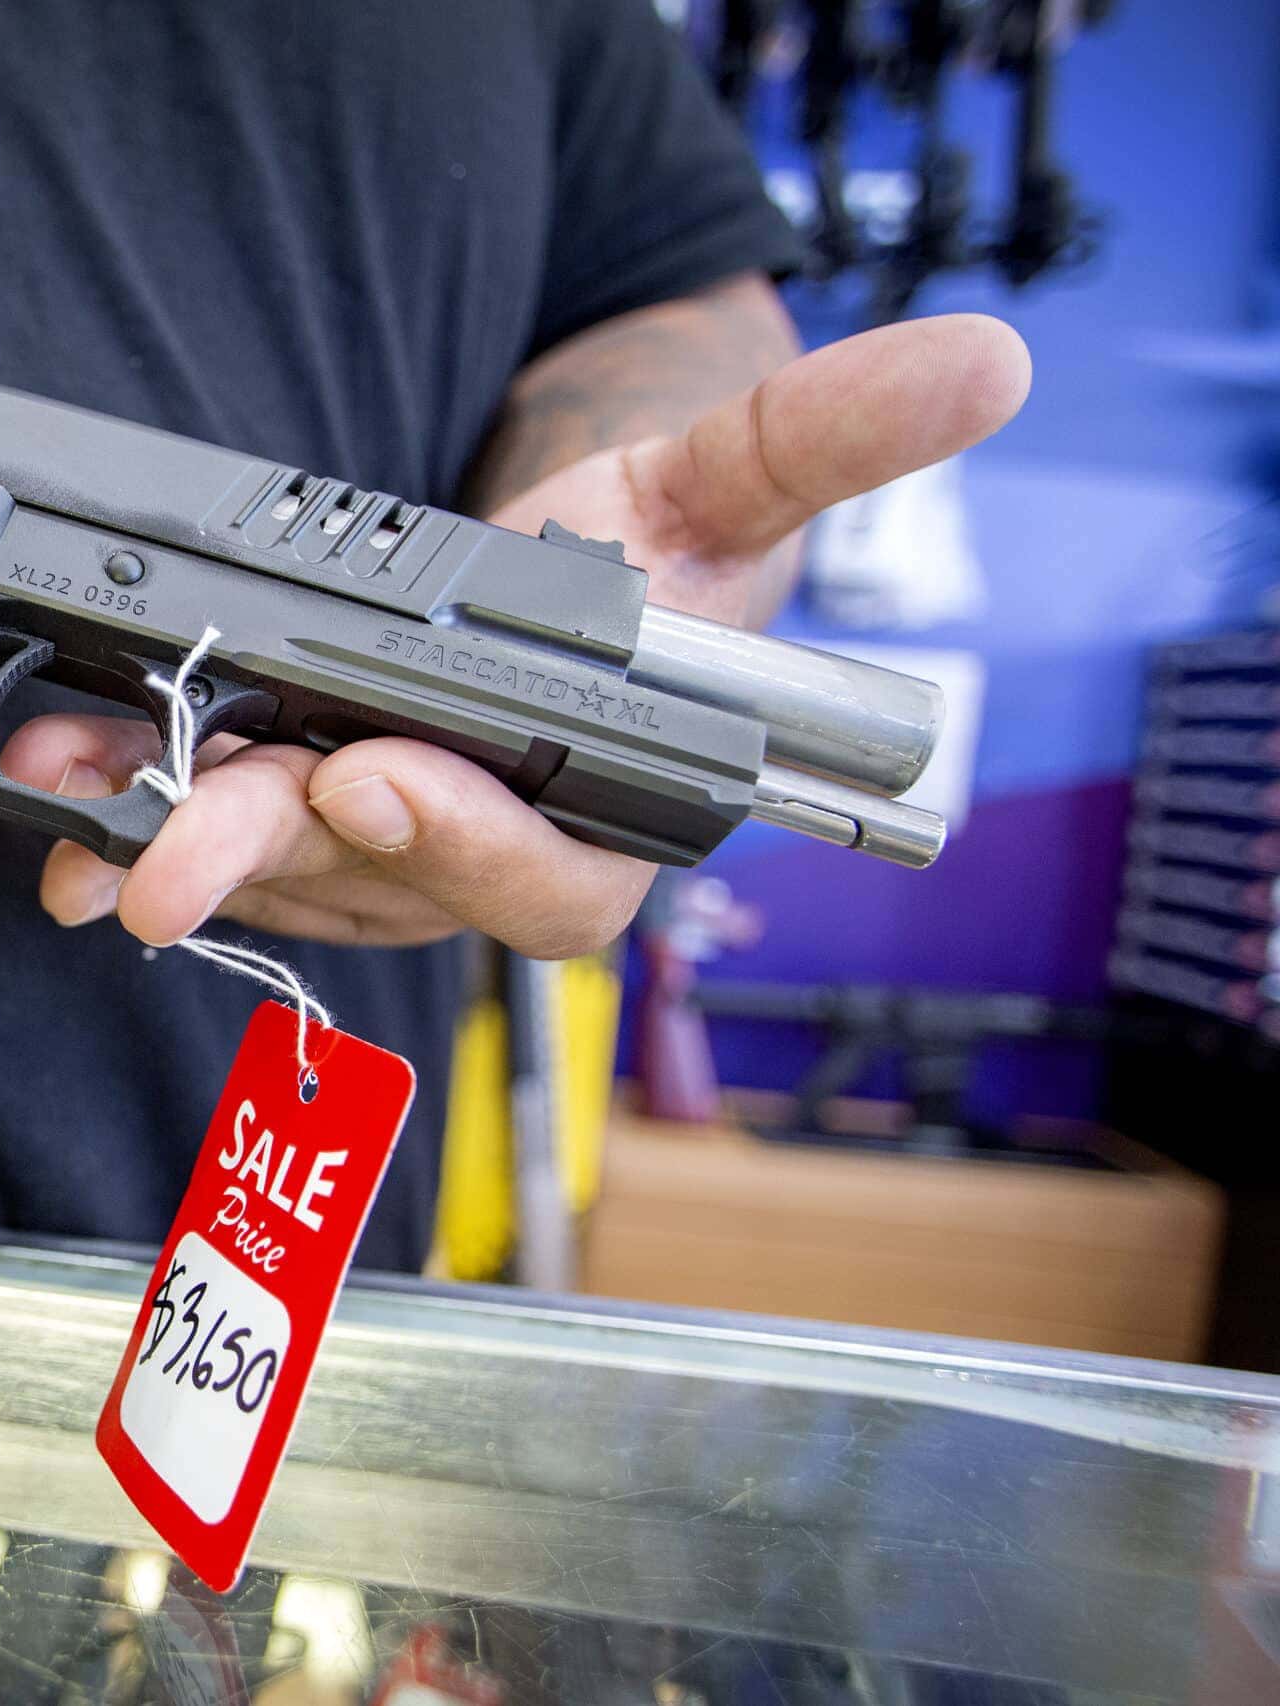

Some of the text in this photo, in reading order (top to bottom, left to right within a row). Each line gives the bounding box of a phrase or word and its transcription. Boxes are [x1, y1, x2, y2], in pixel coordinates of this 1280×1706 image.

[7, 562, 148, 616] XL22 0396
[375, 629, 661, 731] STACCATO XL
[218, 1099, 349, 1232] SALE
[209, 1186, 286, 1273] Price
[138, 1257, 277, 1413] $3,650
